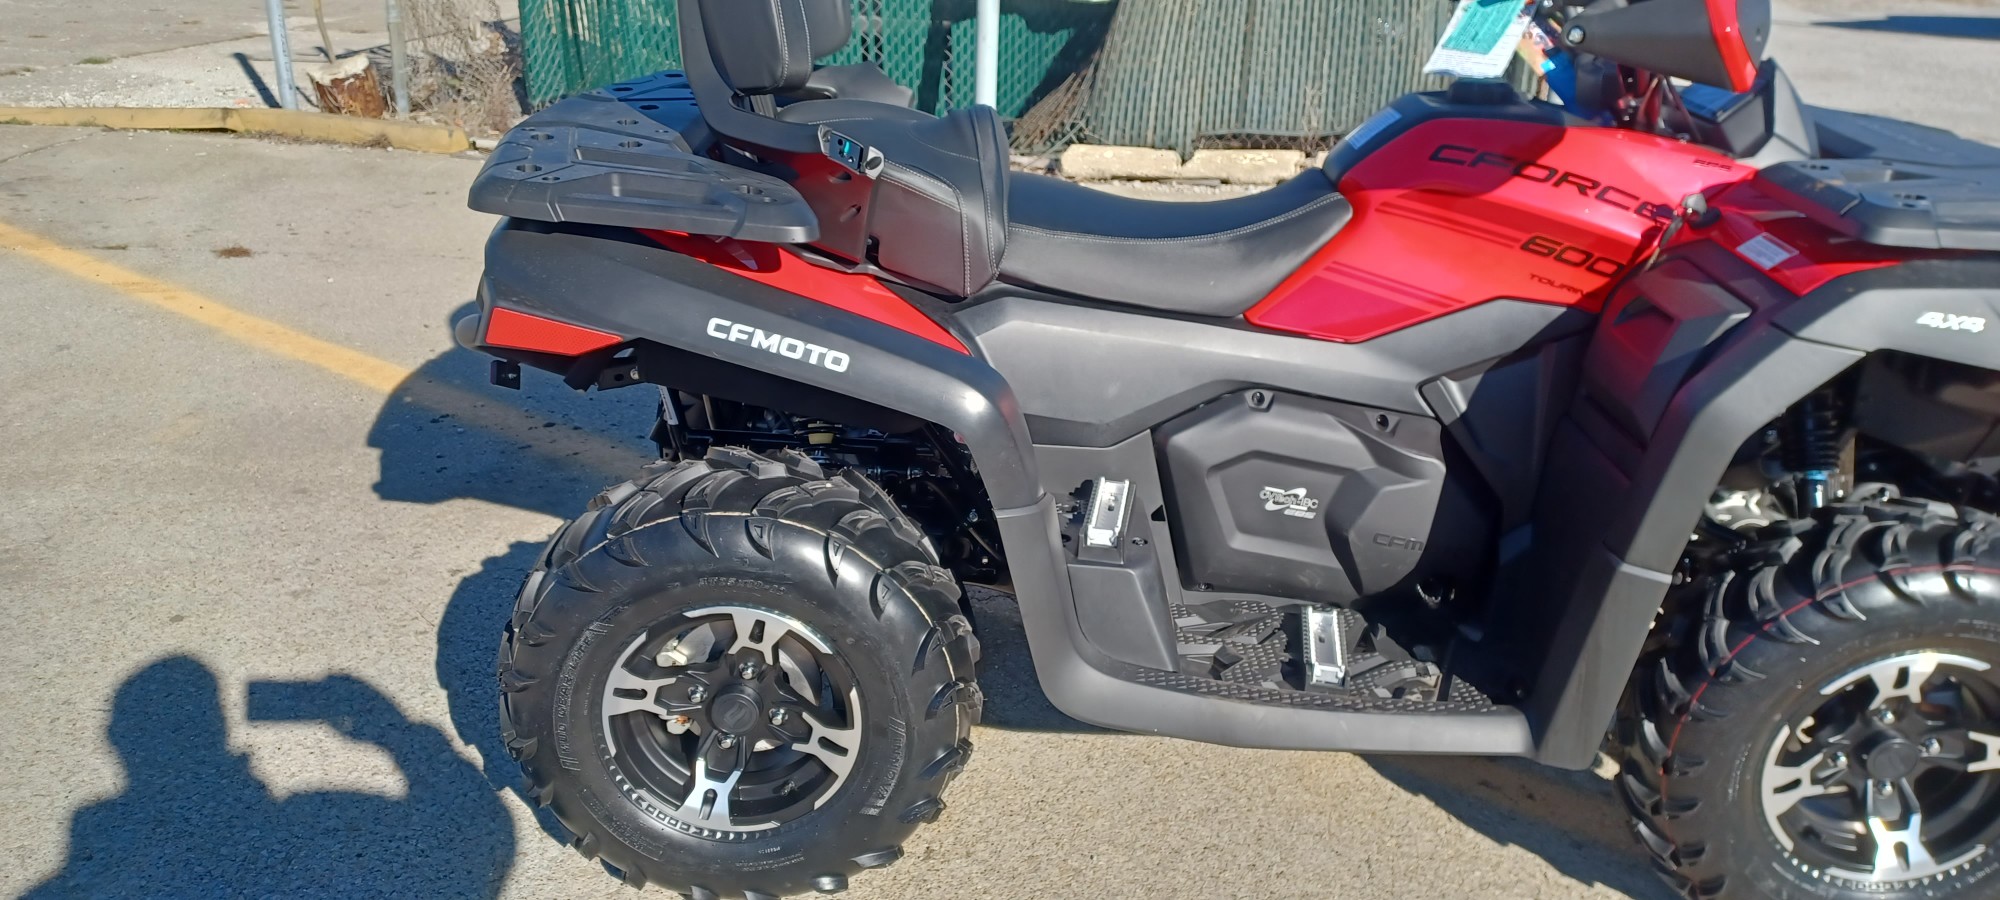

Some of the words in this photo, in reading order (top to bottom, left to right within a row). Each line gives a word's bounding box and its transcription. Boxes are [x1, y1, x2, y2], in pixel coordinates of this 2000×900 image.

[1429, 144, 1676, 228] CFORCE
[1520, 235, 1625, 278] 600
[707, 317, 850, 373] CFMOTO
